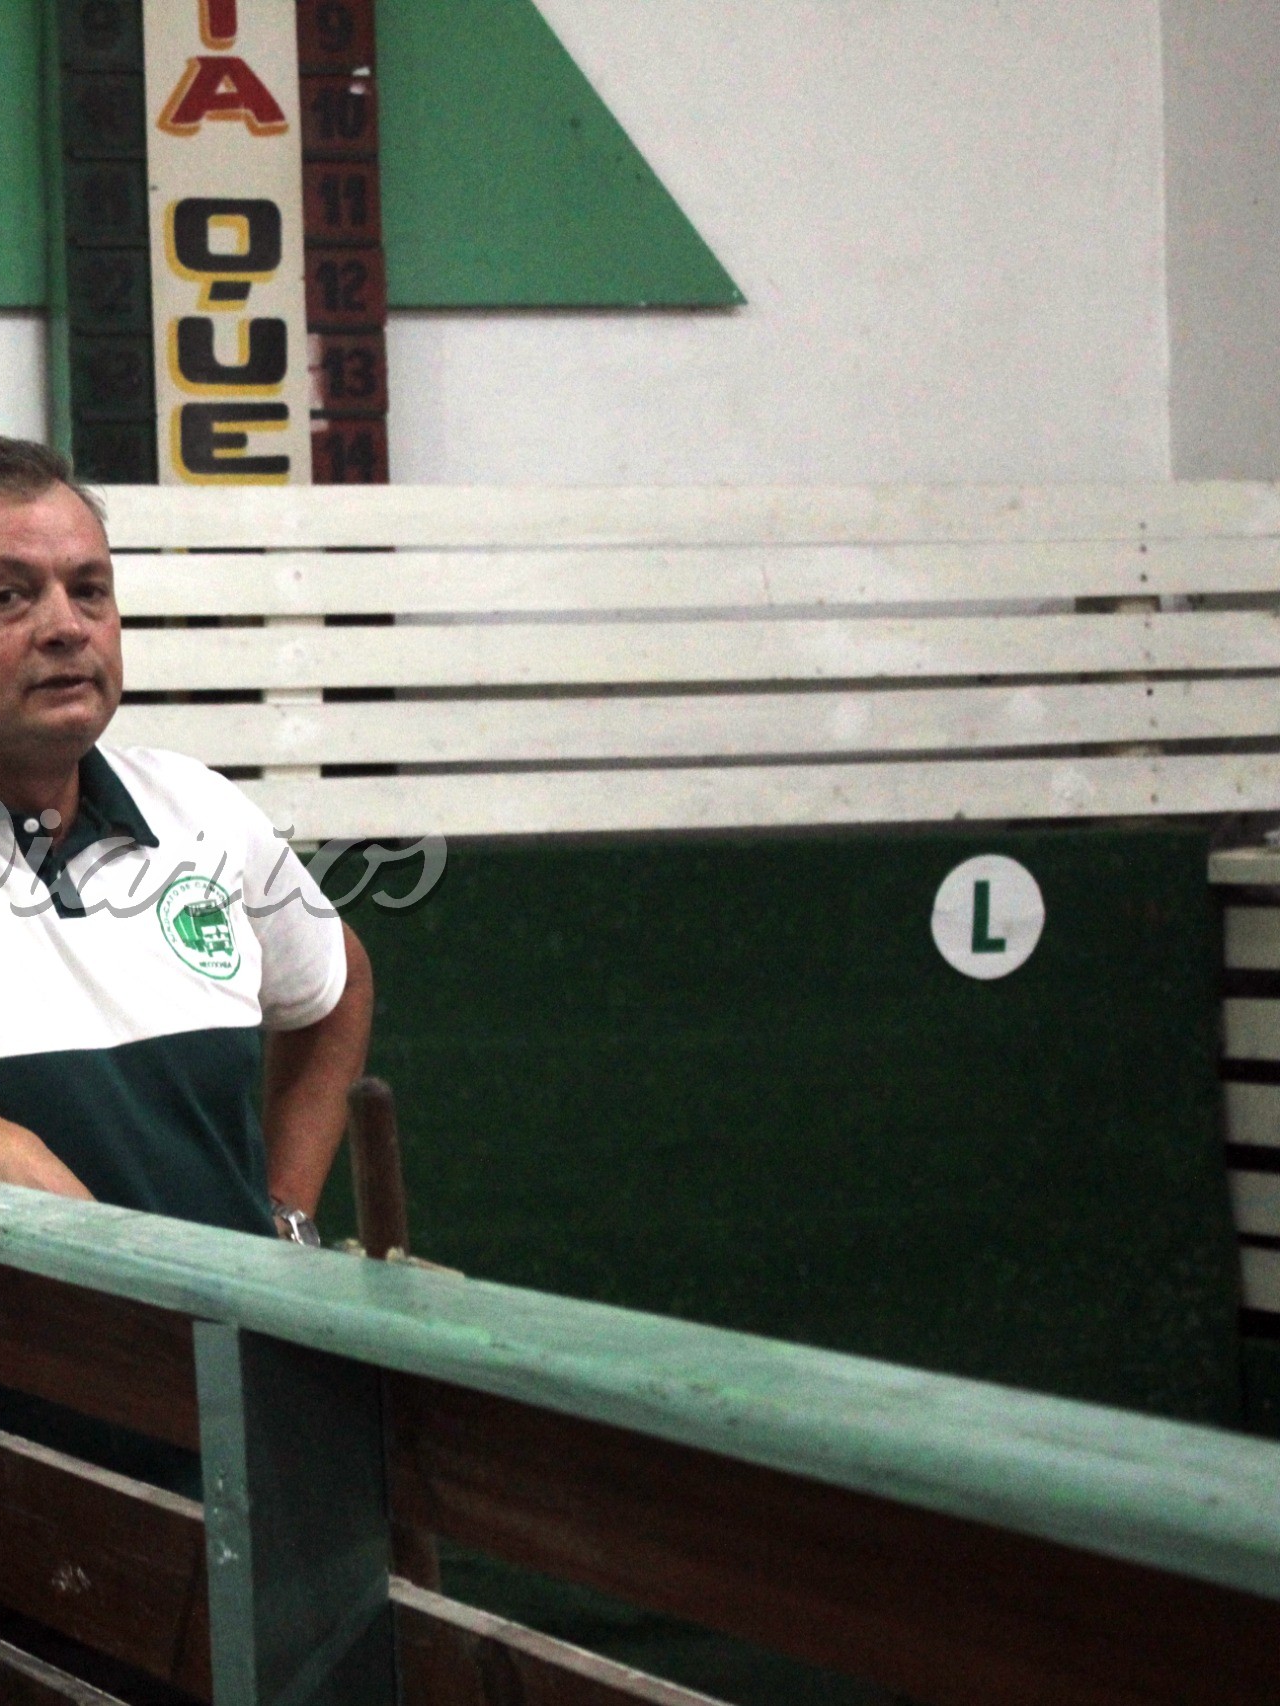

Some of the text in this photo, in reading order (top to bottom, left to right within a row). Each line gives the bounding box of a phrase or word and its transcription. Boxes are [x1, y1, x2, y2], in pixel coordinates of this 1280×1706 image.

[312, 86, 366, 139] 10
[318, 174, 368, 228] 11
[316, 260, 368, 312] 12
[322, 347, 377, 398] 13
[972, 880, 1006, 953] L
